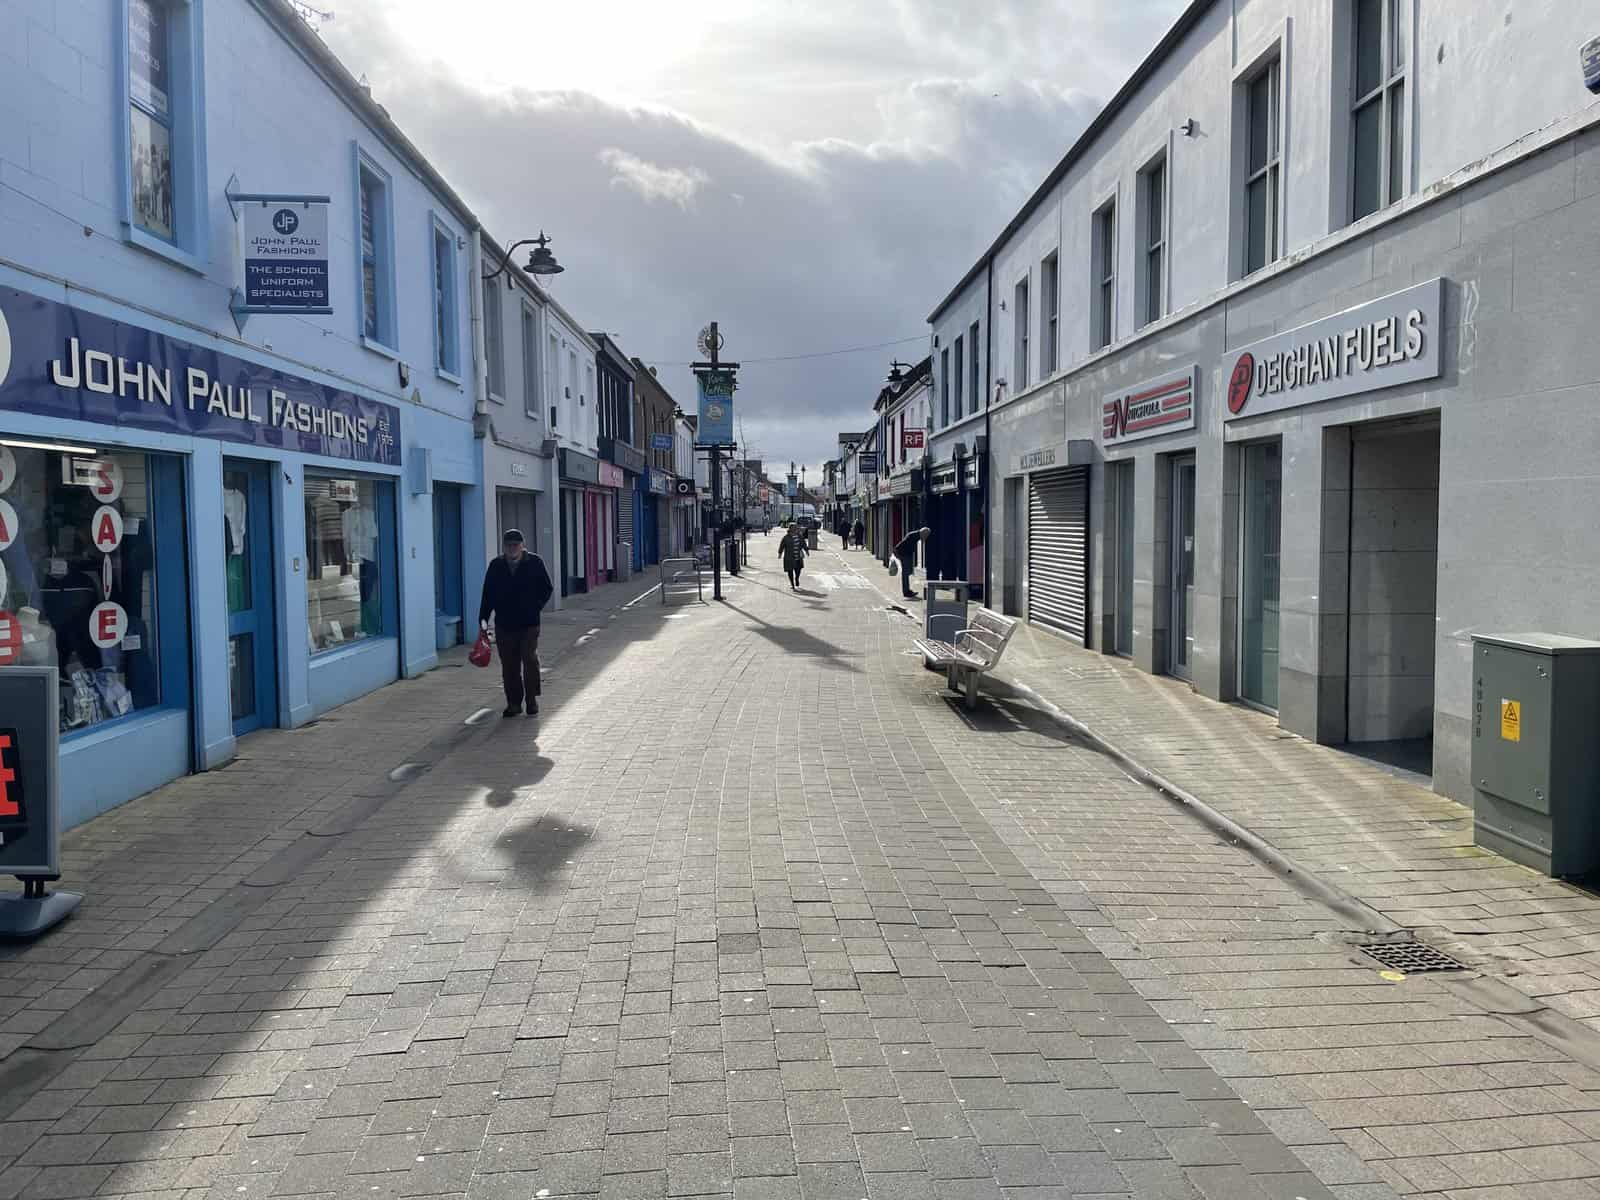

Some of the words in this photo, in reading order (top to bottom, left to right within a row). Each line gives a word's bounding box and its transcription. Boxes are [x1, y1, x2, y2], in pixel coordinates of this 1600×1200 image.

[251, 236, 285, 245] JOHN
[289, 237, 321, 246] PAUL
[257, 246, 316, 255] FASHIONS
[248, 265, 273, 274] THE
[275, 266, 325, 275] SCHOOL
[261, 278, 314, 286] UNIFORM
[250, 289, 324, 298] SPECIALISTS
[1255, 335, 1340, 397] DEIGHAN
[1343, 309, 1423, 375] FUELS
[52, 336, 172, 407] JOHN
[187, 366, 262, 423] PAUL
[271, 388, 369, 444] FASHIONS
